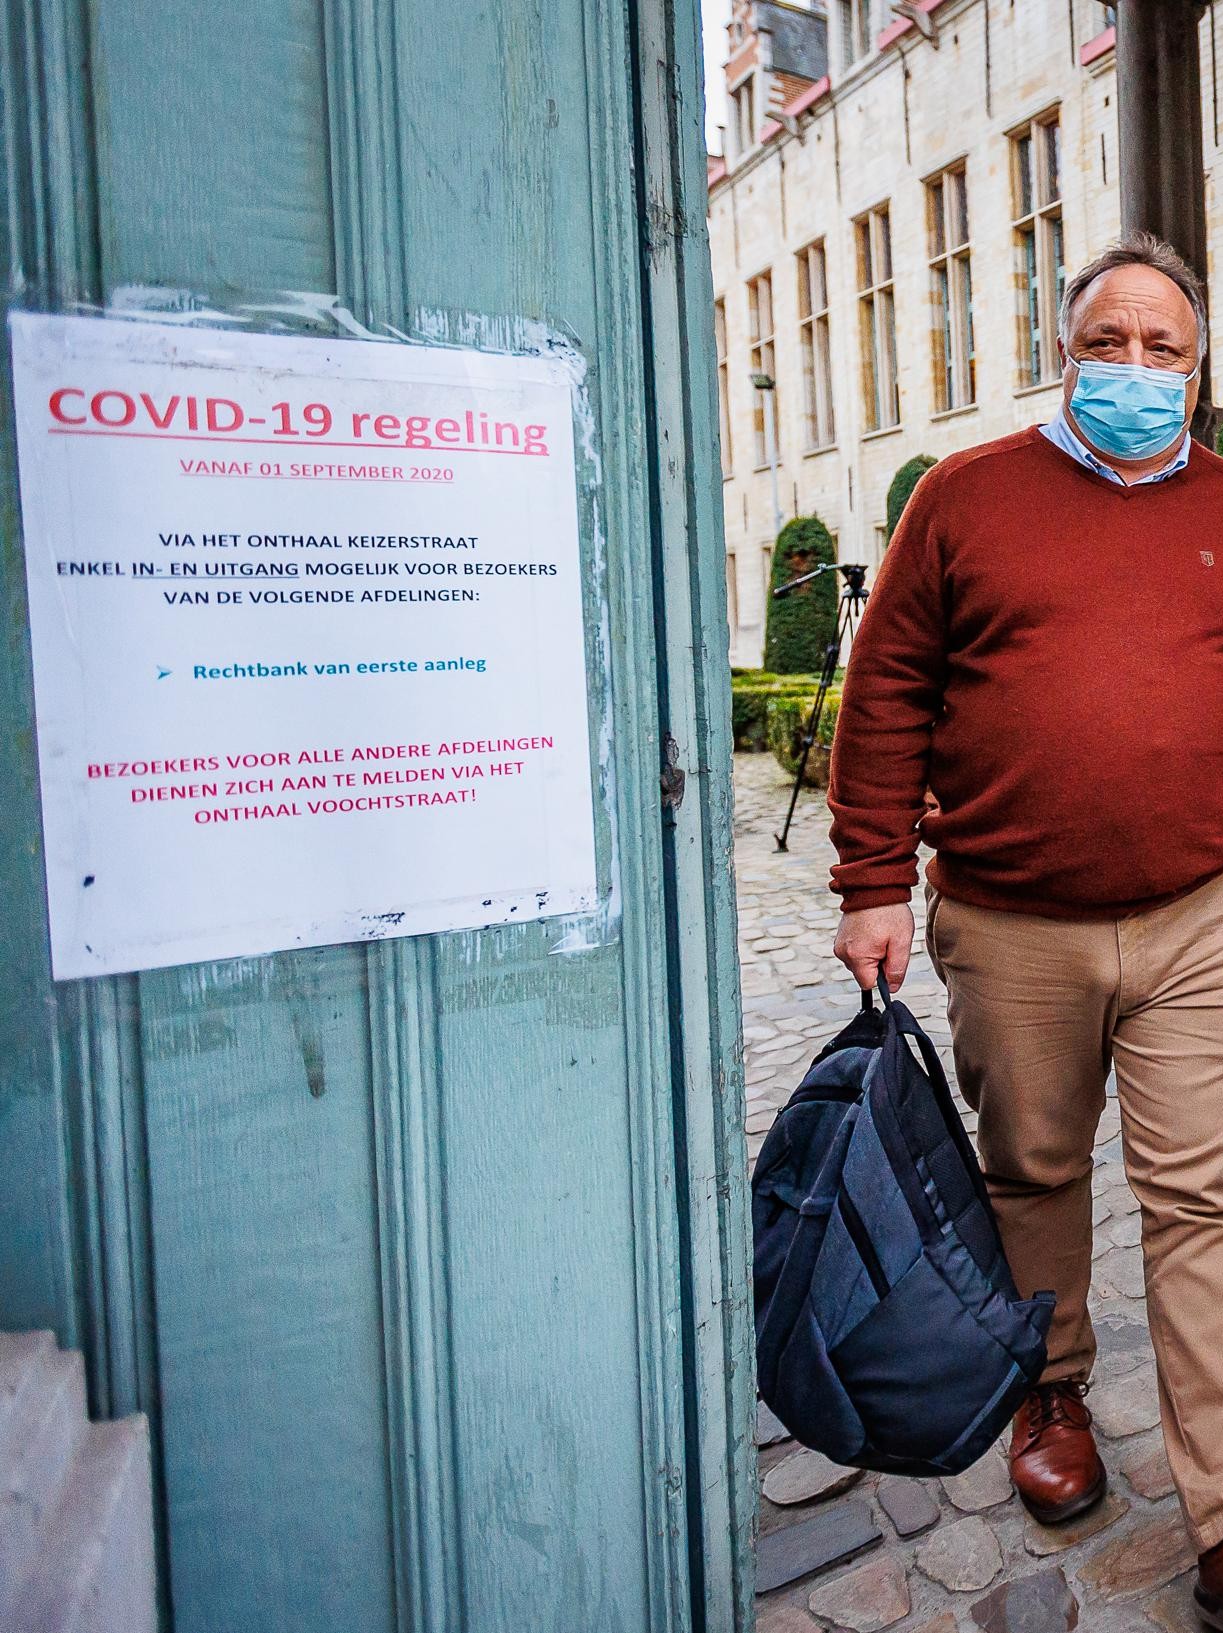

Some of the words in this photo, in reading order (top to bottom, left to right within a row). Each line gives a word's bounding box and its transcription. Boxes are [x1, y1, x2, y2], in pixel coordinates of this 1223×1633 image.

[48, 387, 333, 437] COVID-19
[352, 410, 549, 455] regeling
[180, 459, 254, 475] VANAF
[259, 462, 284, 476] 01
[290, 463, 403, 480] SEPTEMBER
[410, 466, 454, 481] 2020
[159, 534, 195, 546] VIA
[203, 535, 240, 547] HET
[247, 534, 342, 549] ONTHAAL
[347, 534, 479, 549] KEIZERSTRAAT
[57, 562, 123, 575] ENKEL
[132, 562, 163, 576] IN-
[171, 563, 196, 575] EN
[205, 563, 298, 575] UITGANG
[306, 563, 398, 575] MOGELIJK
[405, 563, 457, 574] VOOR
[464, 564, 556, 575] BEZOEKERS
[164, 592, 208, 604] VAN
[217, 592, 241, 603] DE
[249, 591, 354, 603] VOLGENDE
[361, 590, 479, 602] AFDELINGEN:
[194, 662, 307, 678] Rechtbank
[314, 664, 349, 674] van
[357, 661, 417, 673] eerste
[425, 657, 486, 672] aanleg
[88, 758, 219, 778] BEZOEKERS
[227, 753, 290, 768] VOOR
[299, 750, 343, 763] ALLE
[352, 745, 430, 760] ANDERE
[438, 737, 552, 755] AFDELINGEN
[132, 784, 217, 802] DIENEN
[226, 780, 273, 795] ZICH
[282, 776, 325, 790] AAN
[334, 774, 355, 786] TE
[364, 769, 444, 785] MELDEN
[452, 766, 483, 778] VIA
[491, 762, 523, 775] HET
[194, 803, 302, 824] ONTHAAL
[307, 788, 476, 815] VOOCHTSTRAAT!
